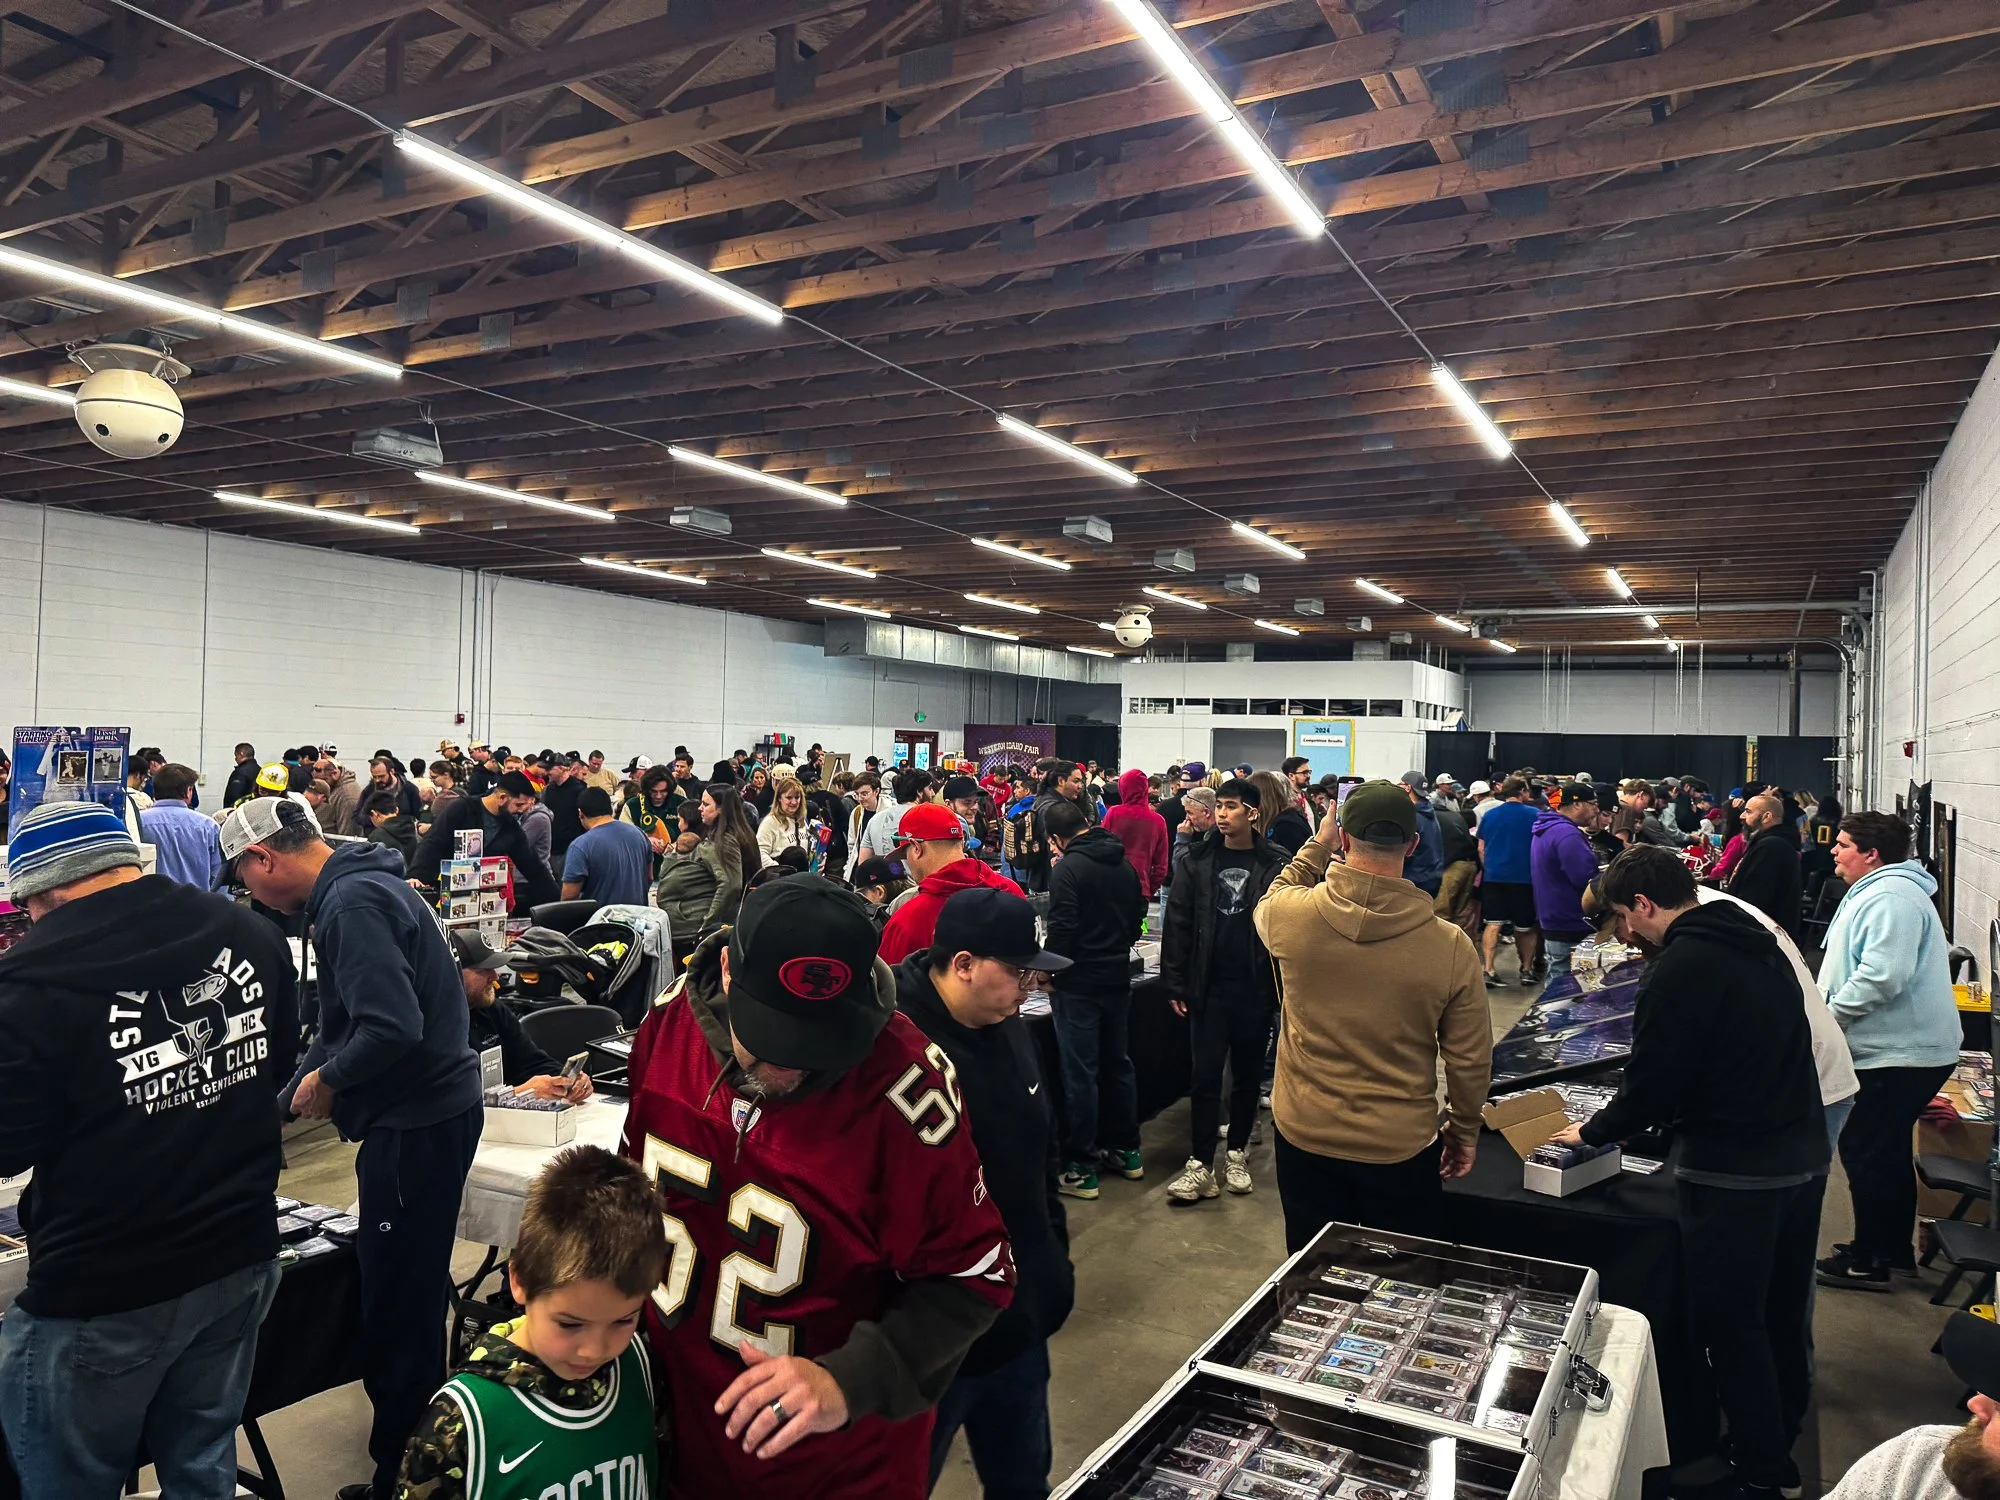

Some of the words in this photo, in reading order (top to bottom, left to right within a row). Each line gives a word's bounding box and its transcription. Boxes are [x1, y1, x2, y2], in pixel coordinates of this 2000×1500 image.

[978, 742, 1006, 755] WESTERN
[1006, 741, 1024, 752] IDAHO
[1024, 744, 1040, 755] FAIR
[240, 1013, 256, 1034] HC
[124, 1055, 214, 1106] HOCKEY
[226, 1037, 268, 1072] CLUB
[131, 1049, 160, 1073] VG
[145, 1088, 196, 1115] VIOLENT
[202, 1065, 257, 1096] GENTLEMEN
[885, 1042, 962, 1146] 52
[642, 1132, 810, 1359] 52
